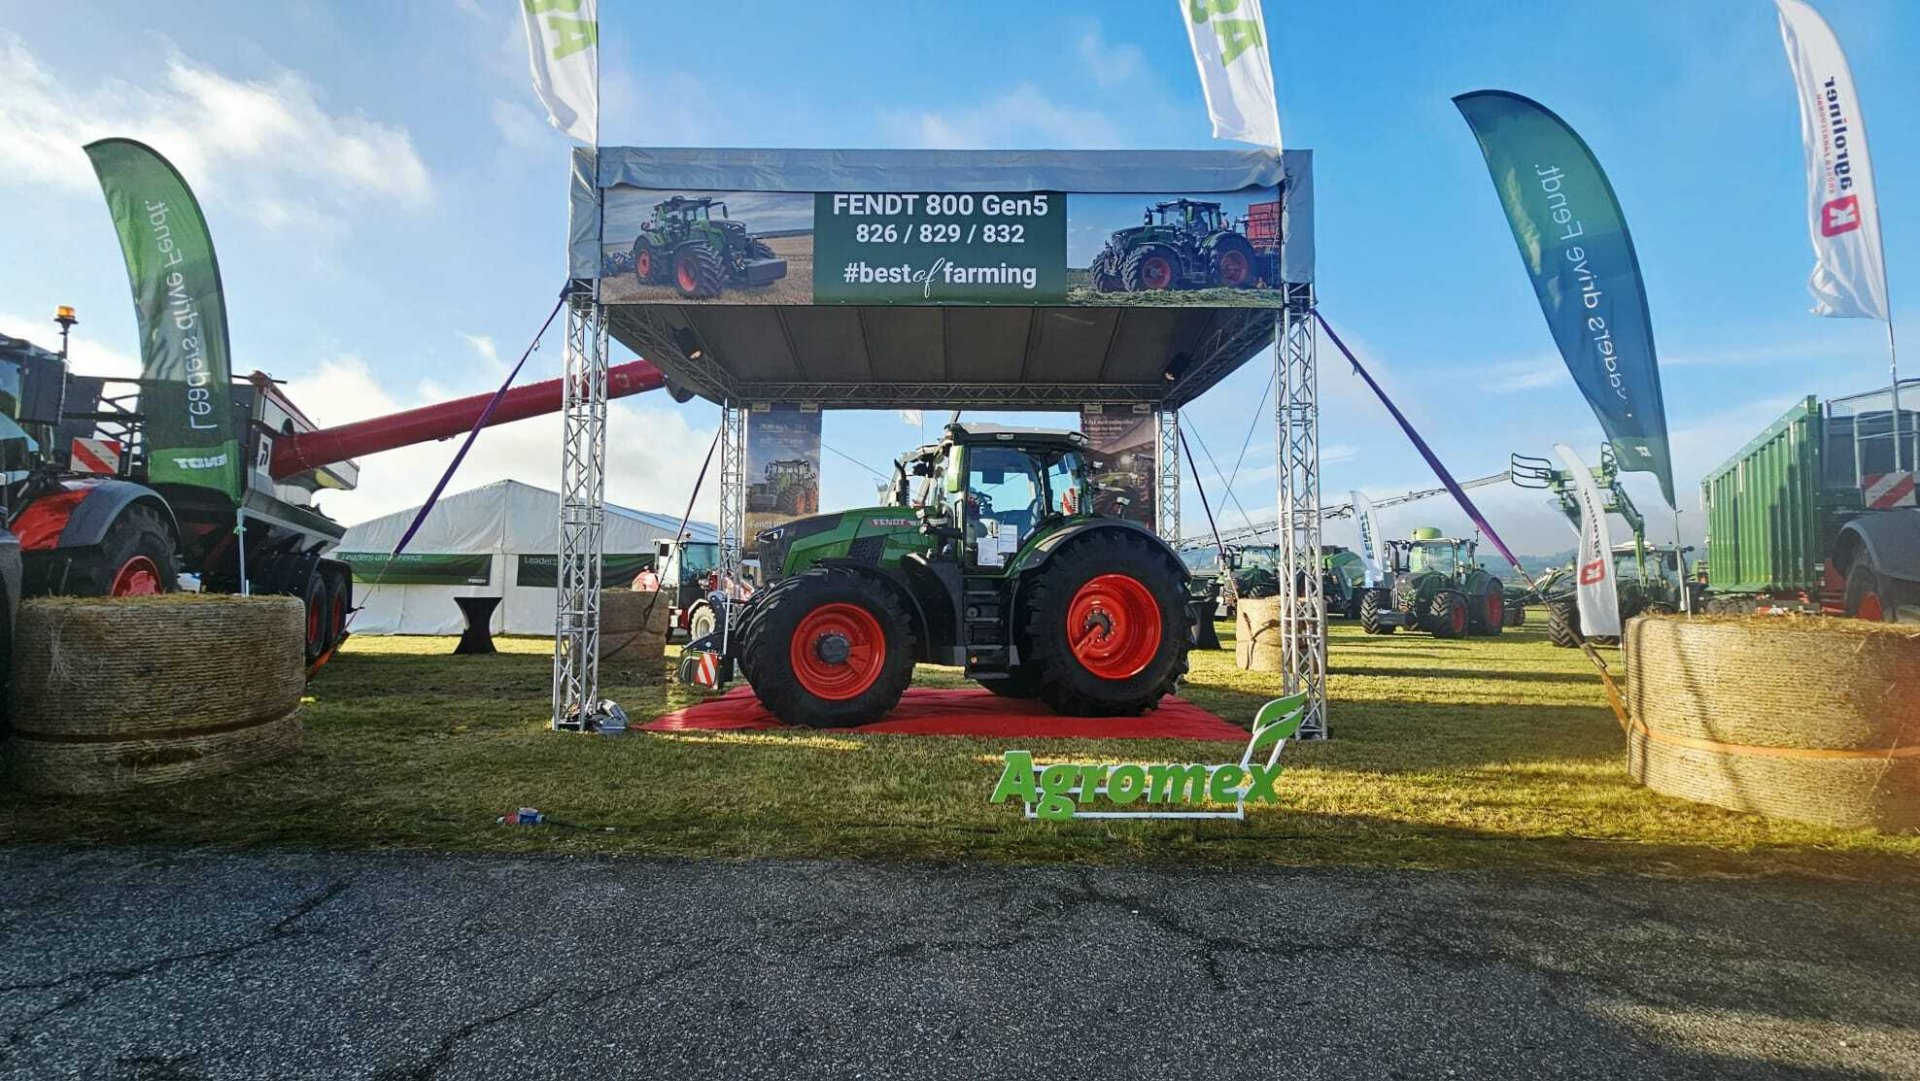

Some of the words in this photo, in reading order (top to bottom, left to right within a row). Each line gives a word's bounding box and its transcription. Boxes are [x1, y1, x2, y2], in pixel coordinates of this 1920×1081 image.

[832, 194, 919, 216] FENDT
[925, 194, 974, 216] 800
[982, 194, 1048, 216] Gen5
[856, 224, 898, 243] 826
[903, 224, 914, 244] /
[919, 224, 961, 243] 829
[967, 224, 977, 244] /
[982, 224, 1025, 243] 832
[990, 750, 1284, 820] Agromex
